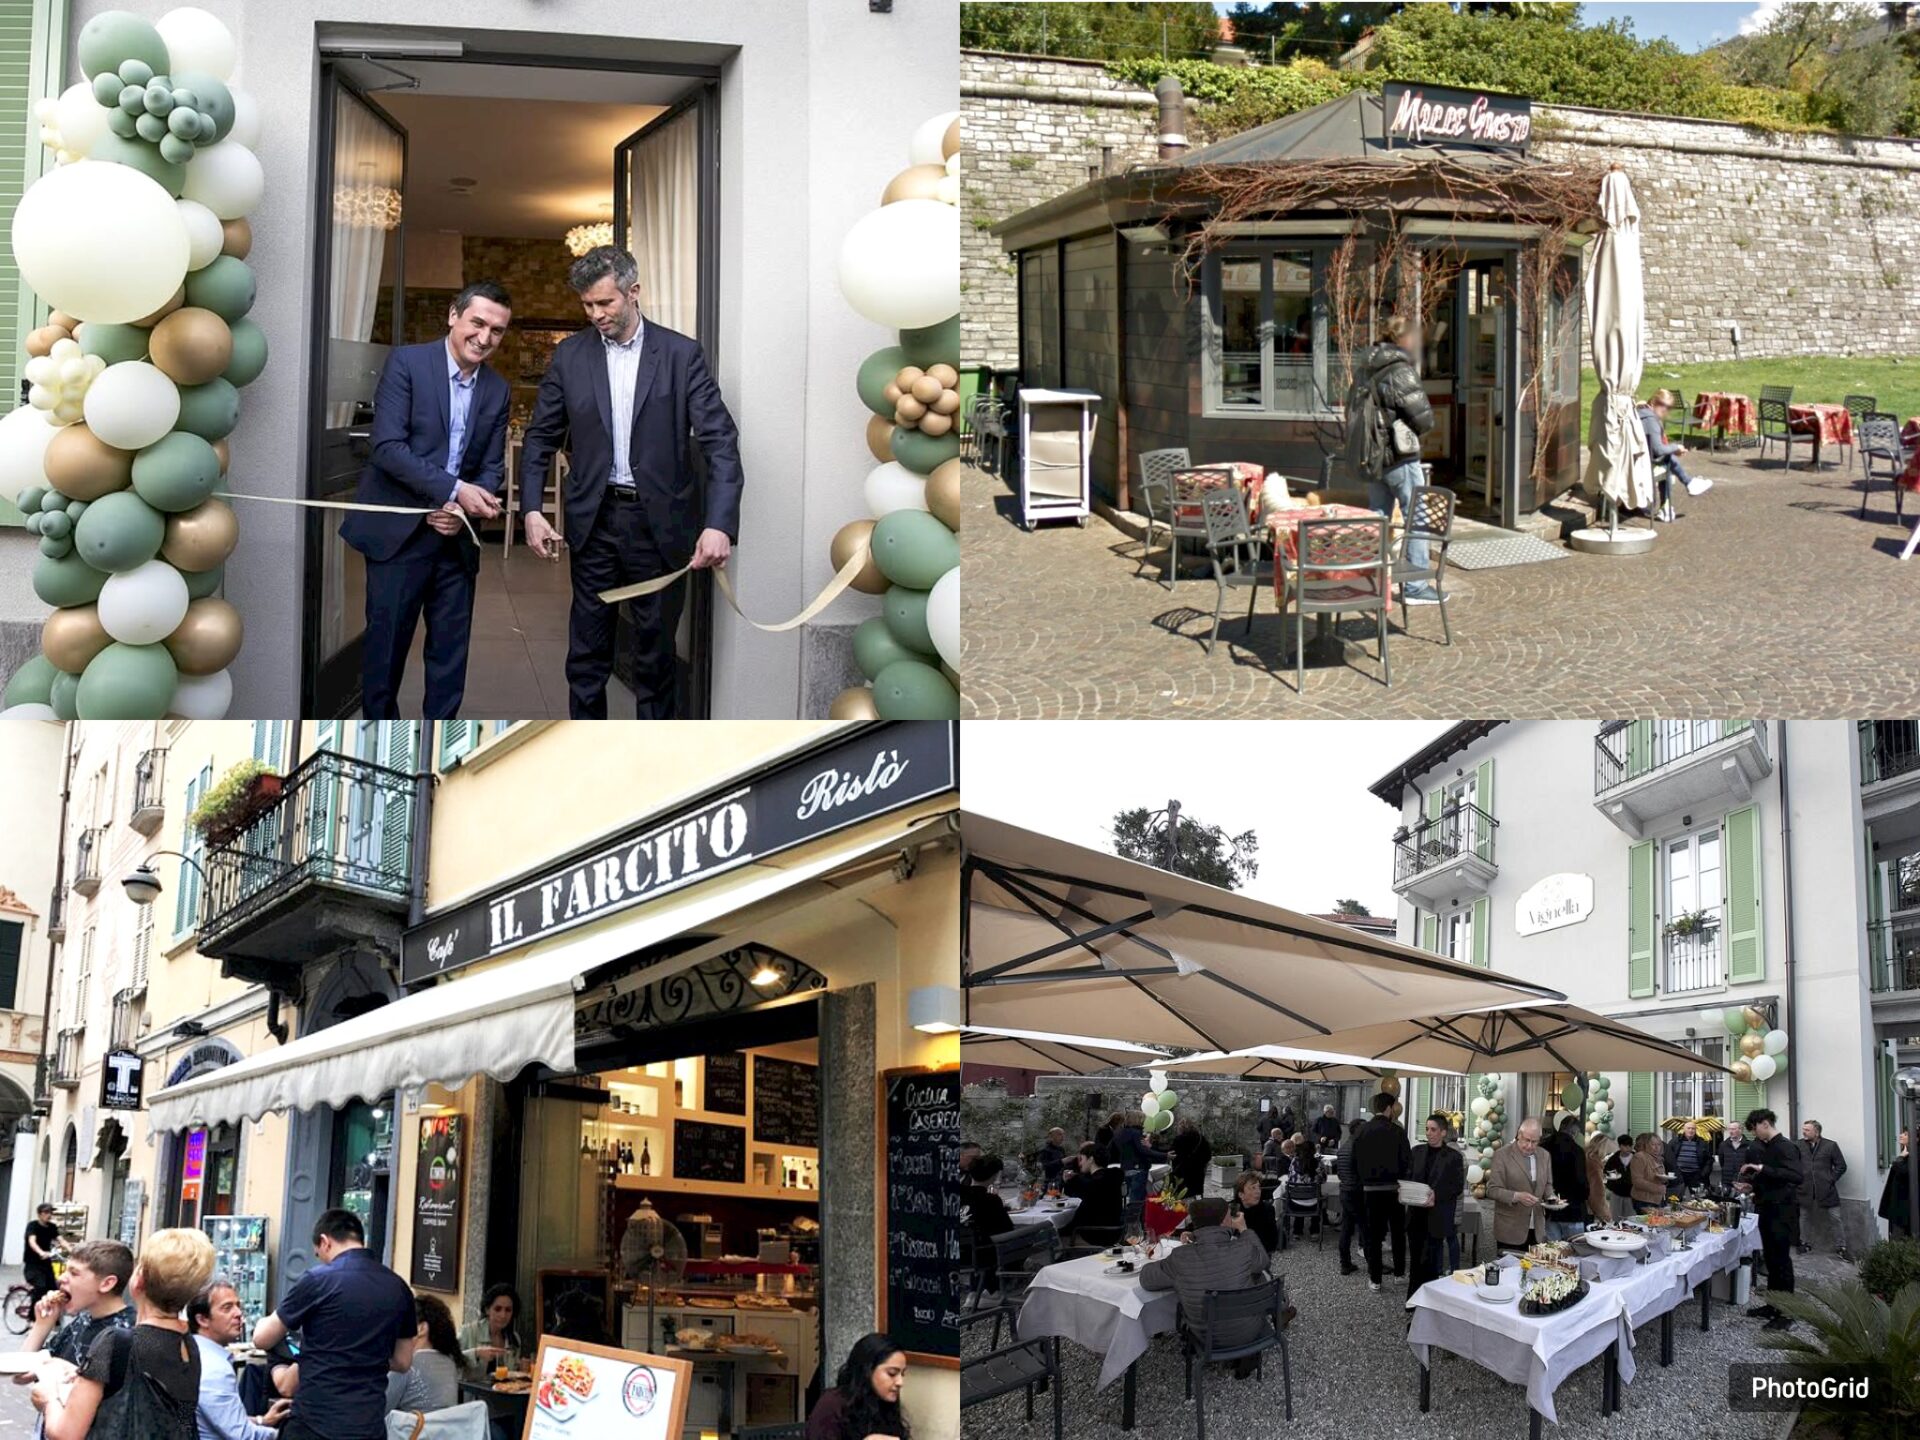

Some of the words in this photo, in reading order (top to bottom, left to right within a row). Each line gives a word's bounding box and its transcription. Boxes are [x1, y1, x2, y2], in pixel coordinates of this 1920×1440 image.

[489, 899, 523, 947] IL
[541, 802, 749, 928] FARCITO
[796, 749, 910, 820] Ristò
[1528, 898, 1580, 927] Vignella
[905, 1082, 950, 1108] CUCINA
